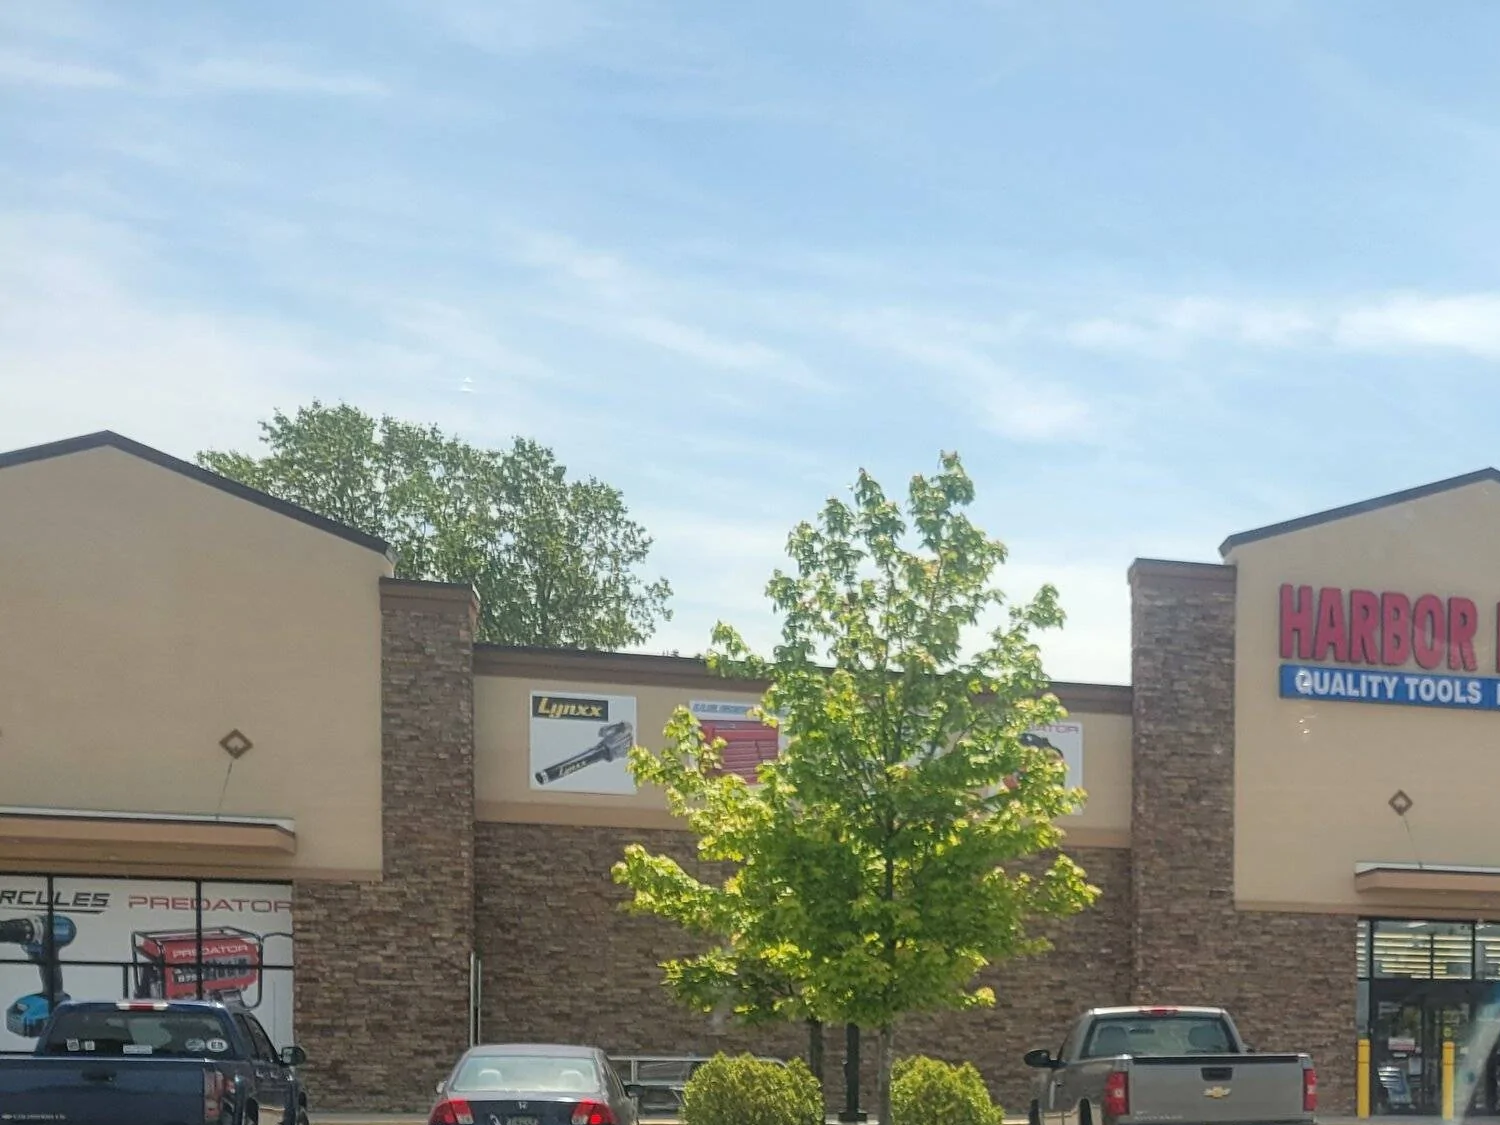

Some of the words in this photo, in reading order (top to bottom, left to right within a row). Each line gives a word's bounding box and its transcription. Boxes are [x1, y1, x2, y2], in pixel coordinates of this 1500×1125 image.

[1279, 583, 1478, 671] HARBOR
[1294, 670, 1401, 699] QUALITY
[1404, 676, 1482, 704] TOOLS
[536, 696, 603, 719] Lynxx
[128, 893, 293, 913] PREDATOR
[172, 944, 249, 959] PREDATOR
